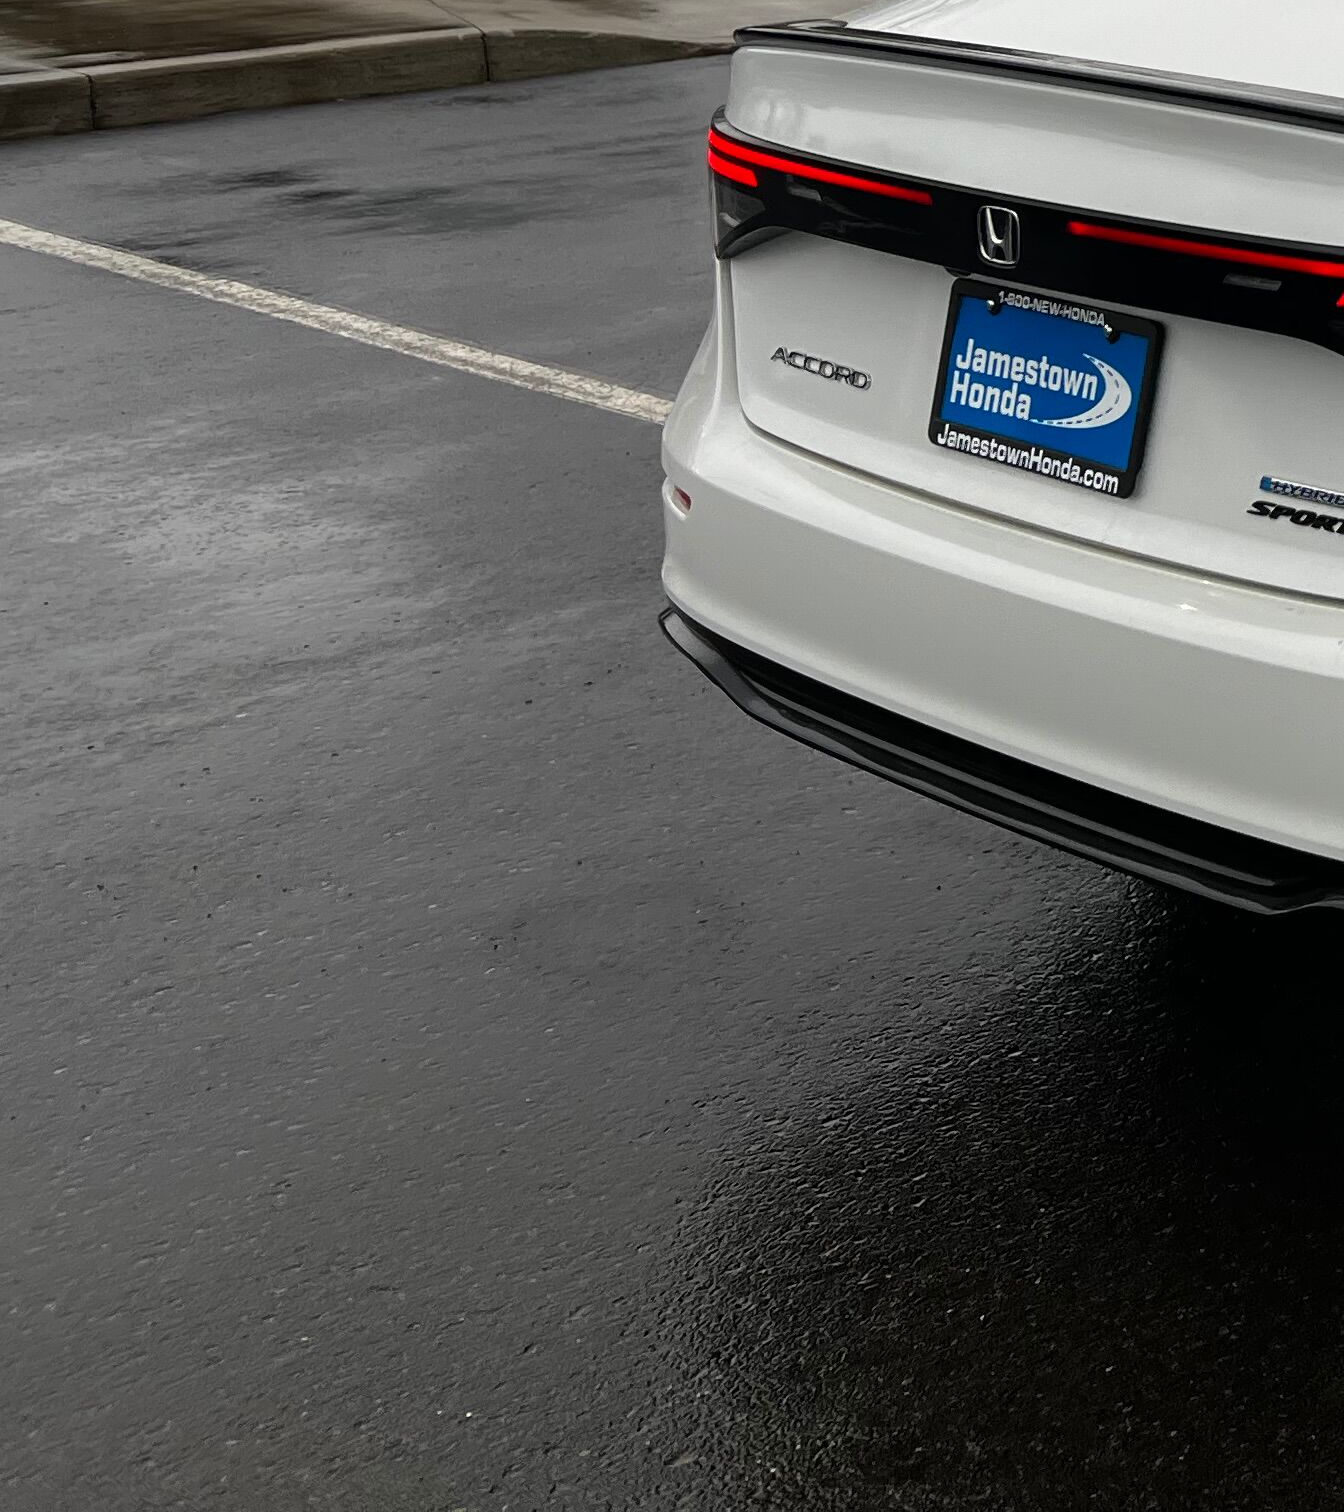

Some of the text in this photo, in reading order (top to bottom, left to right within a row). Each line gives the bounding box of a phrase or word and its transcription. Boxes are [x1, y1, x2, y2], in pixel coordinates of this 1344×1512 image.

[998, 291, 1105, 326] 1-800-NEW-HONDA
[771, 347, 872, 390] ACCORD
[956, 338, 1098, 402] Jamestown
[950, 370, 1032, 421] Honda
[937, 423, 1119, 494] JamestownHonda.com
